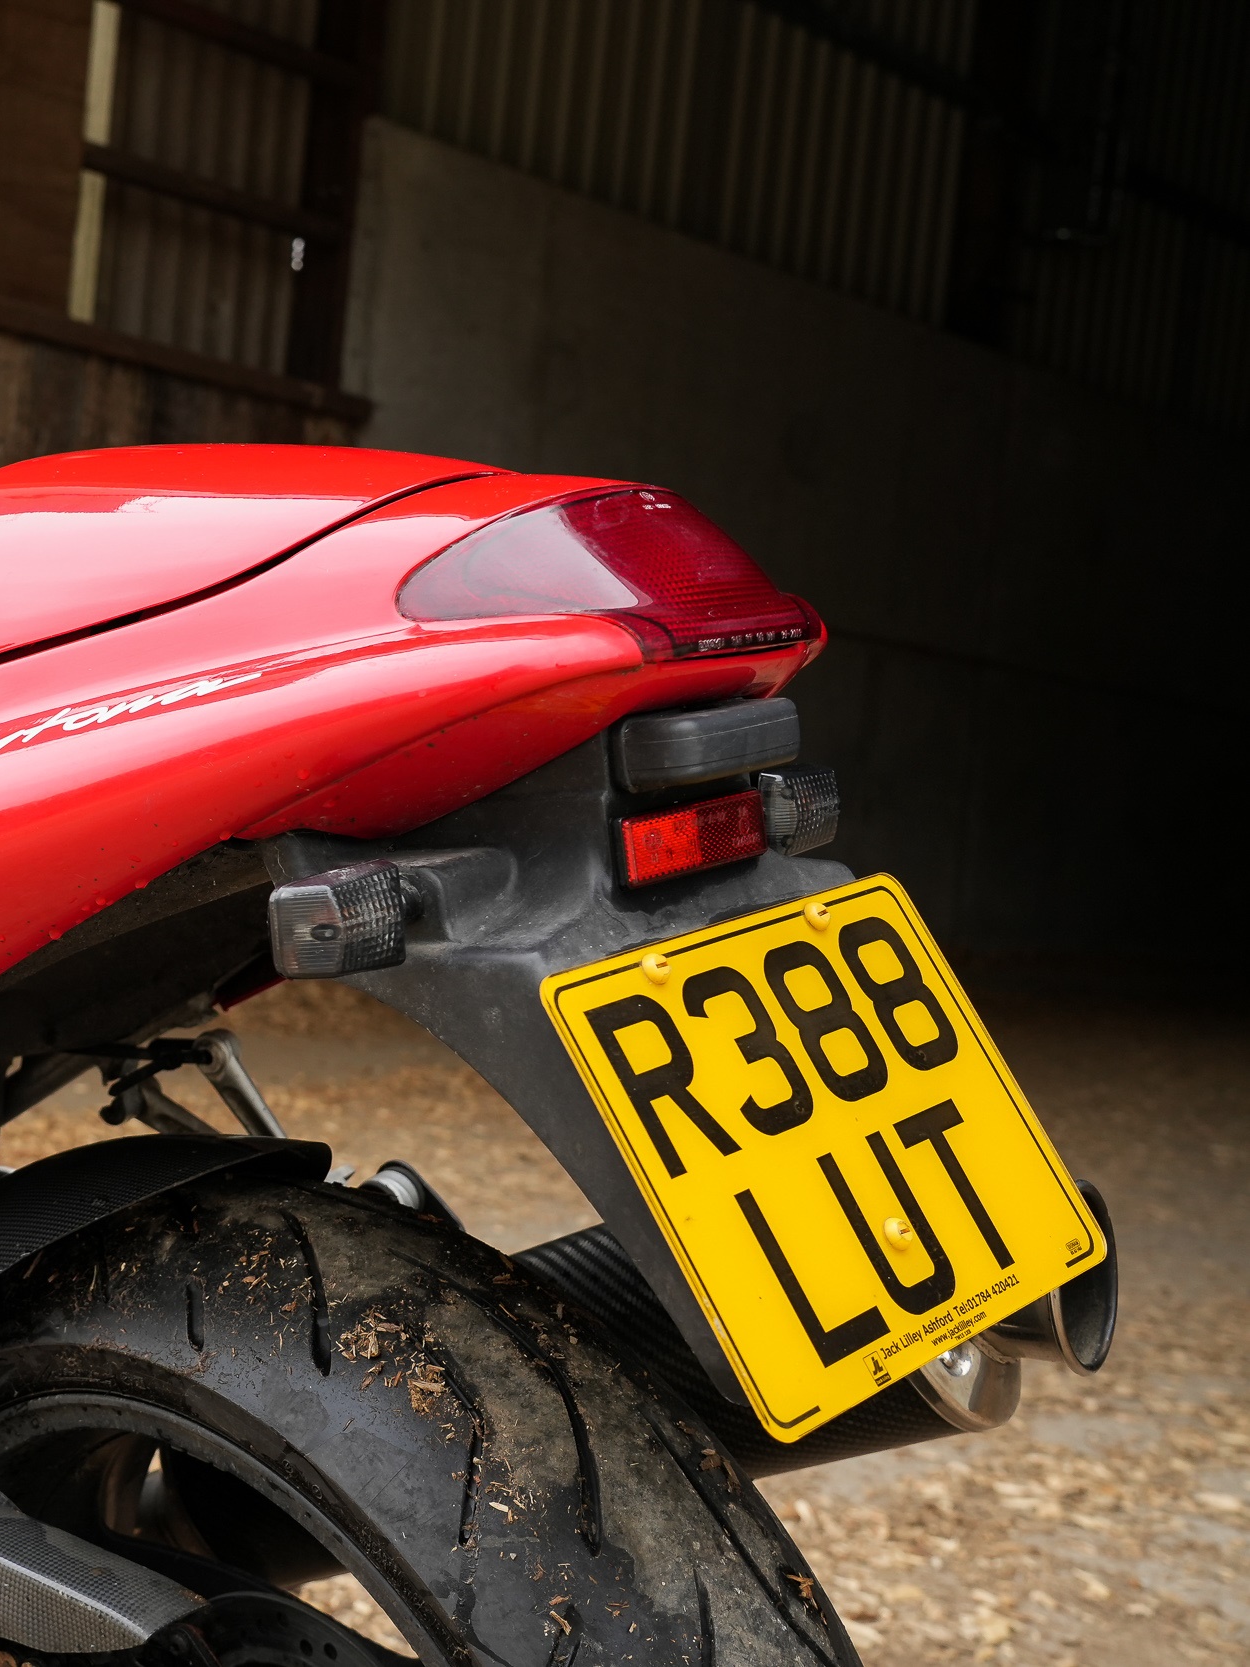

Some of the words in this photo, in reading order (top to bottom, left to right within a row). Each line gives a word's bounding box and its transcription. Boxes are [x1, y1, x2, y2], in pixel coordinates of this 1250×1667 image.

[582, 916, 959, 1179] R388
[735, 1099, 1015, 1369] LUT
[880, 1341, 902, 1359] Jack
[900, 1330, 924, 1349] Lilley
[922, 1310, 954, 1336] Ashford
[953, 1288, 992, 1317] Tel:01784
[991, 1274, 1020, 1296] 420421
[931, 1311, 987, 1347] www.jacklilley.com
